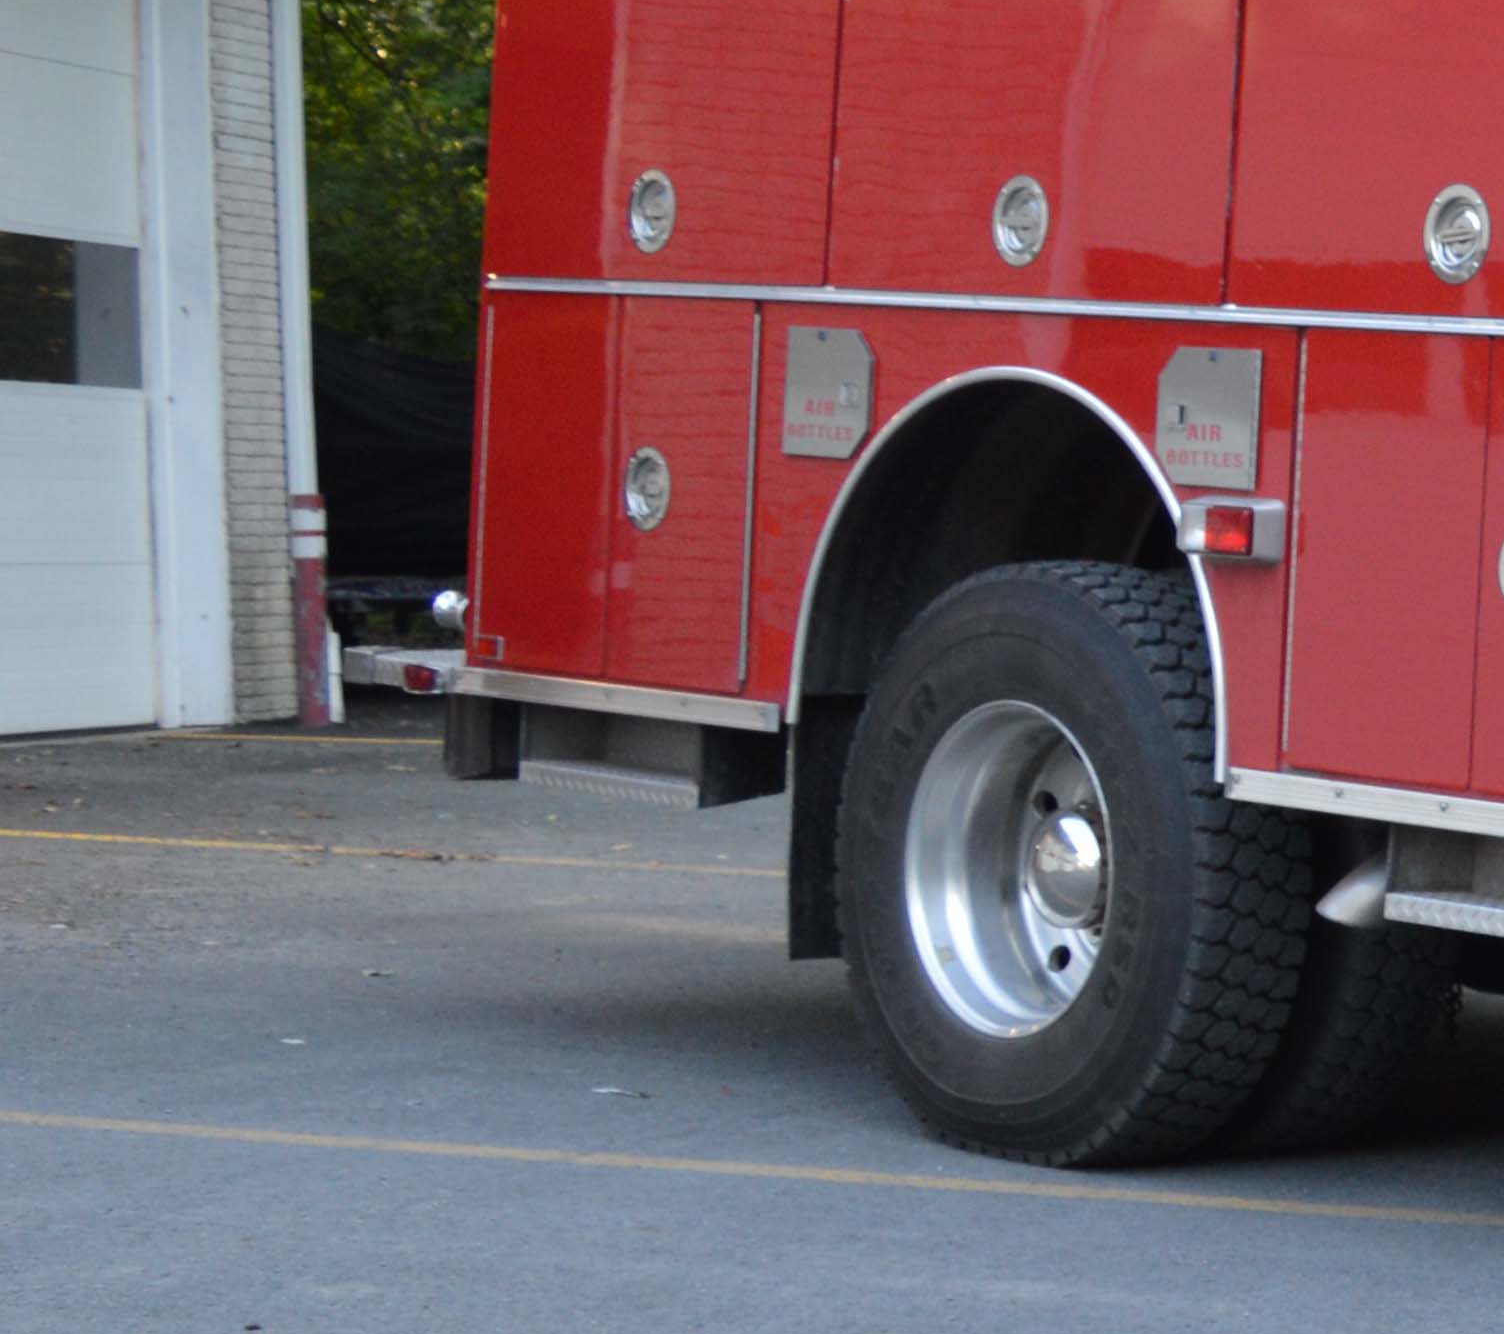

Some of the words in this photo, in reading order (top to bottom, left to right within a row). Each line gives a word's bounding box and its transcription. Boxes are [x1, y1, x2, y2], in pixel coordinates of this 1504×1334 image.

[803, 397, 834, 417] AIR
[786, 422, 855, 443] BOTTLES
[1185, 422, 1223, 442] AIR
[1165, 448, 1244, 468] BOTTLES
